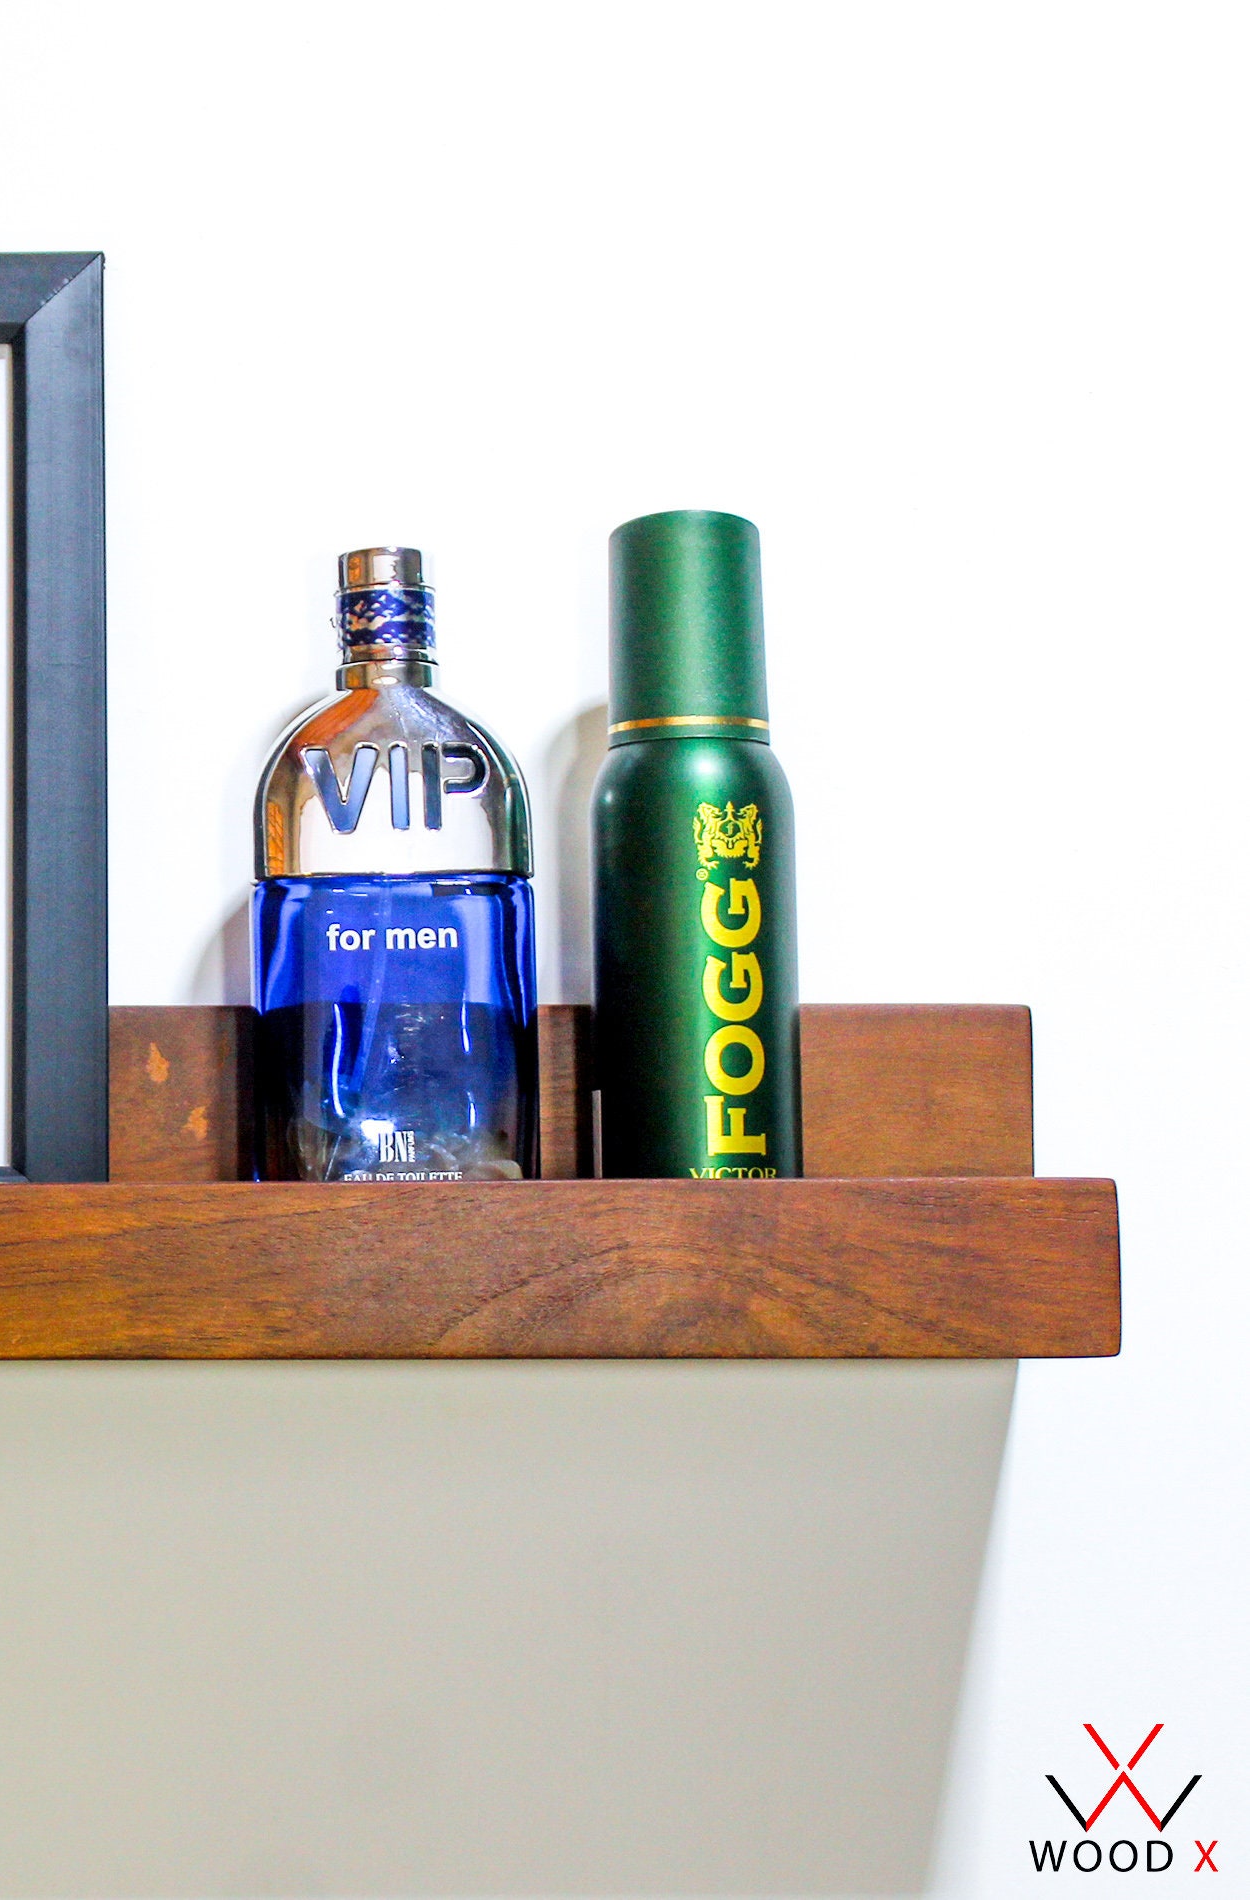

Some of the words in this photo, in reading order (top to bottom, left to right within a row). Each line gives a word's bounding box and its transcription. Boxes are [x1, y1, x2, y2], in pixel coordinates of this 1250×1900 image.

[300, 740, 490, 834] VIP
[326, 923, 376, 951] for
[385, 926, 459, 950] men
[700, 876, 767, 1157] FOGG
[379, 1130, 408, 1162] BN
[688, 1166, 777, 1179] VICTOR
